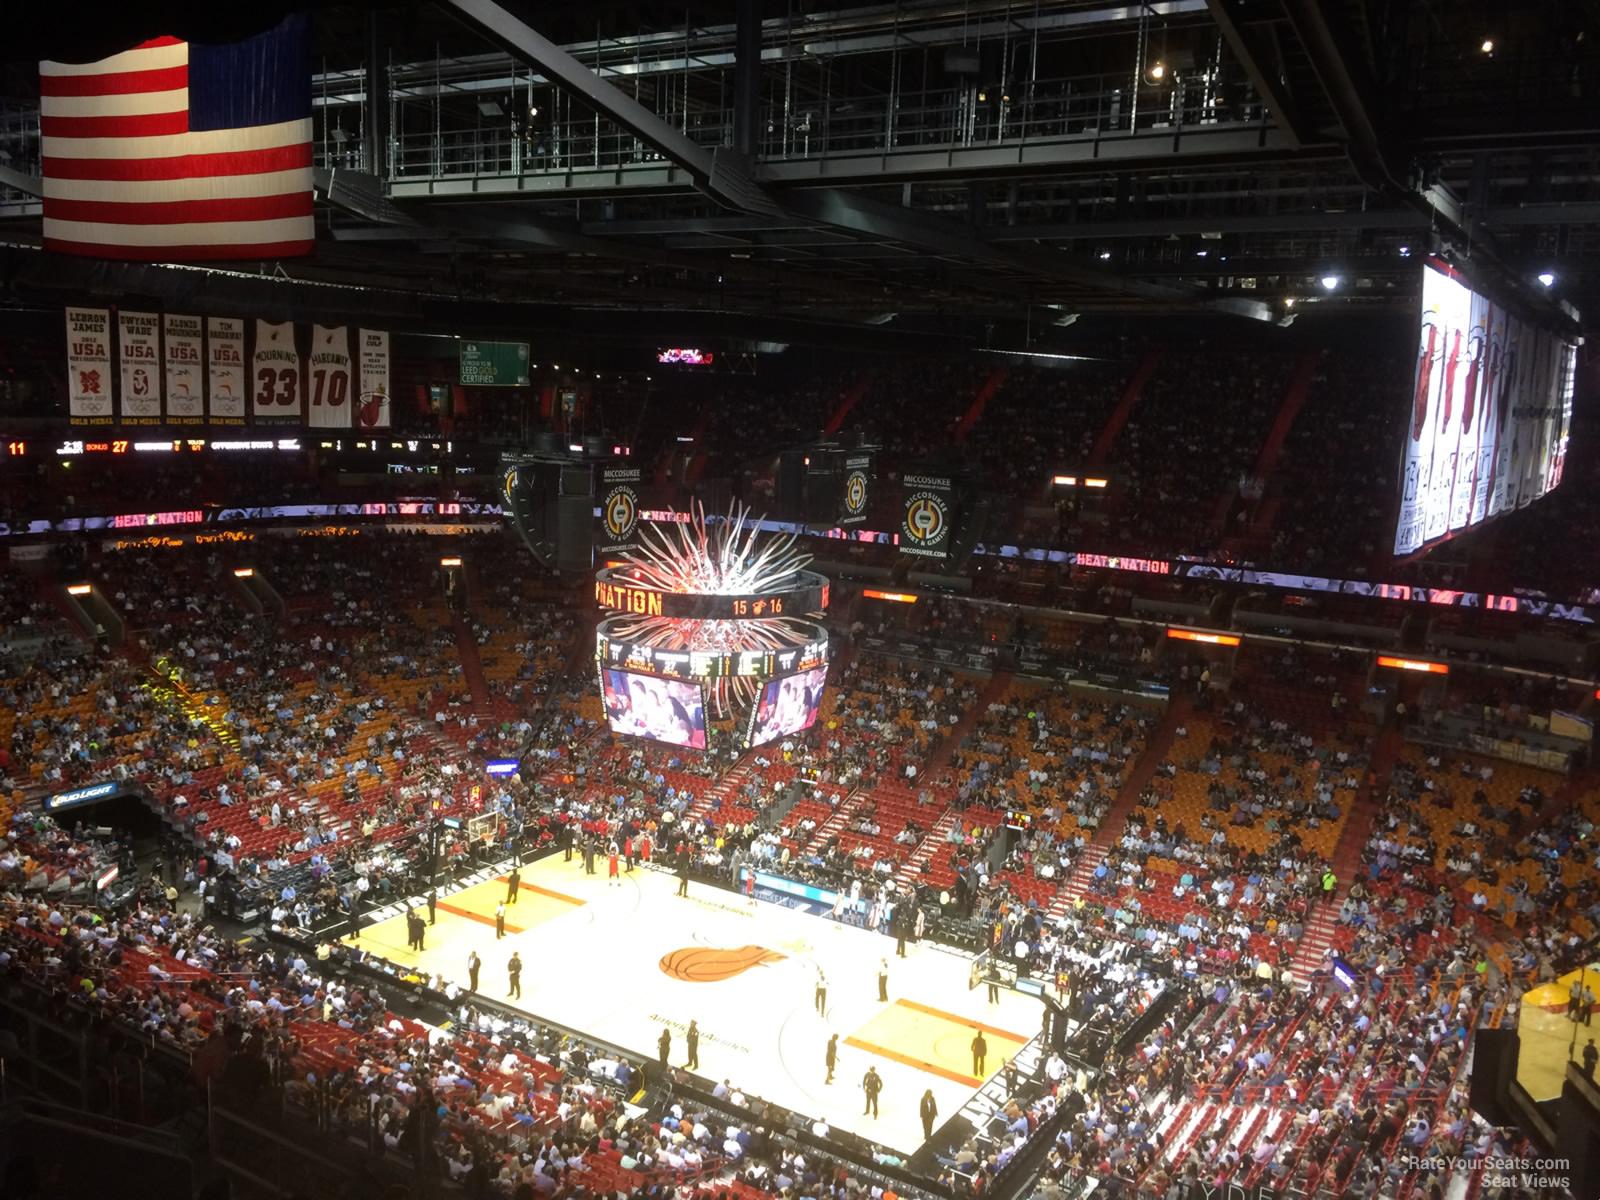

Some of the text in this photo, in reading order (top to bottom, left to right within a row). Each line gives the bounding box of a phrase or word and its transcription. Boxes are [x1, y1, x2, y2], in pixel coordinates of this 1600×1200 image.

[70, 312, 106, 323] LEBRON
[120, 315, 158, 327] DWYANE
[169, 319, 197, 328] ALONZO
[72, 323, 104, 333] JAMES
[126, 326, 152, 336] WADE
[219, 322, 232, 330] TIM
[72, 343, 105, 356] USA
[125, 345, 155, 358] USA
[170, 347, 198, 360] USA
[213, 349, 241, 361] USA
[255, 350, 296, 364] MOURNING
[311, 352, 348, 367] HARDAWAY
[462, 366, 478, 375] LEED
[462, 374, 494, 383] CERTIFIED
[256, 367, 297, 406] 33
[312, 369, 348, 406] 10
[90, 416, 113, 425] MEDAL
[138, 417, 161, 425] MEDAL
[183, 417, 204, 425] MEDAL
[225, 417, 246, 425] MEDAL
[9, 442, 24, 454] 11
[86, 443, 108, 451] BONUS
[113, 441, 128, 452] 27
[604, 469, 641, 478] MICCOSUKEE
[903, 475, 951, 486] MICCOSUKEE
[605, 485, 638, 504] MICCOSUKEE
[905, 491, 948, 512] MICCOSUKEE
[115, 510, 202, 529] HEAT NATION
[927, 525, 948, 546] GAMING
[899, 547, 947, 558] MICCOSUKEE.COM
[1077, 553, 1169, 574] HEAT NATION
[599, 582, 661, 616] NATION
[733, 598, 782, 615] 15 16
[80, 785, 113, 798] LIGHT
